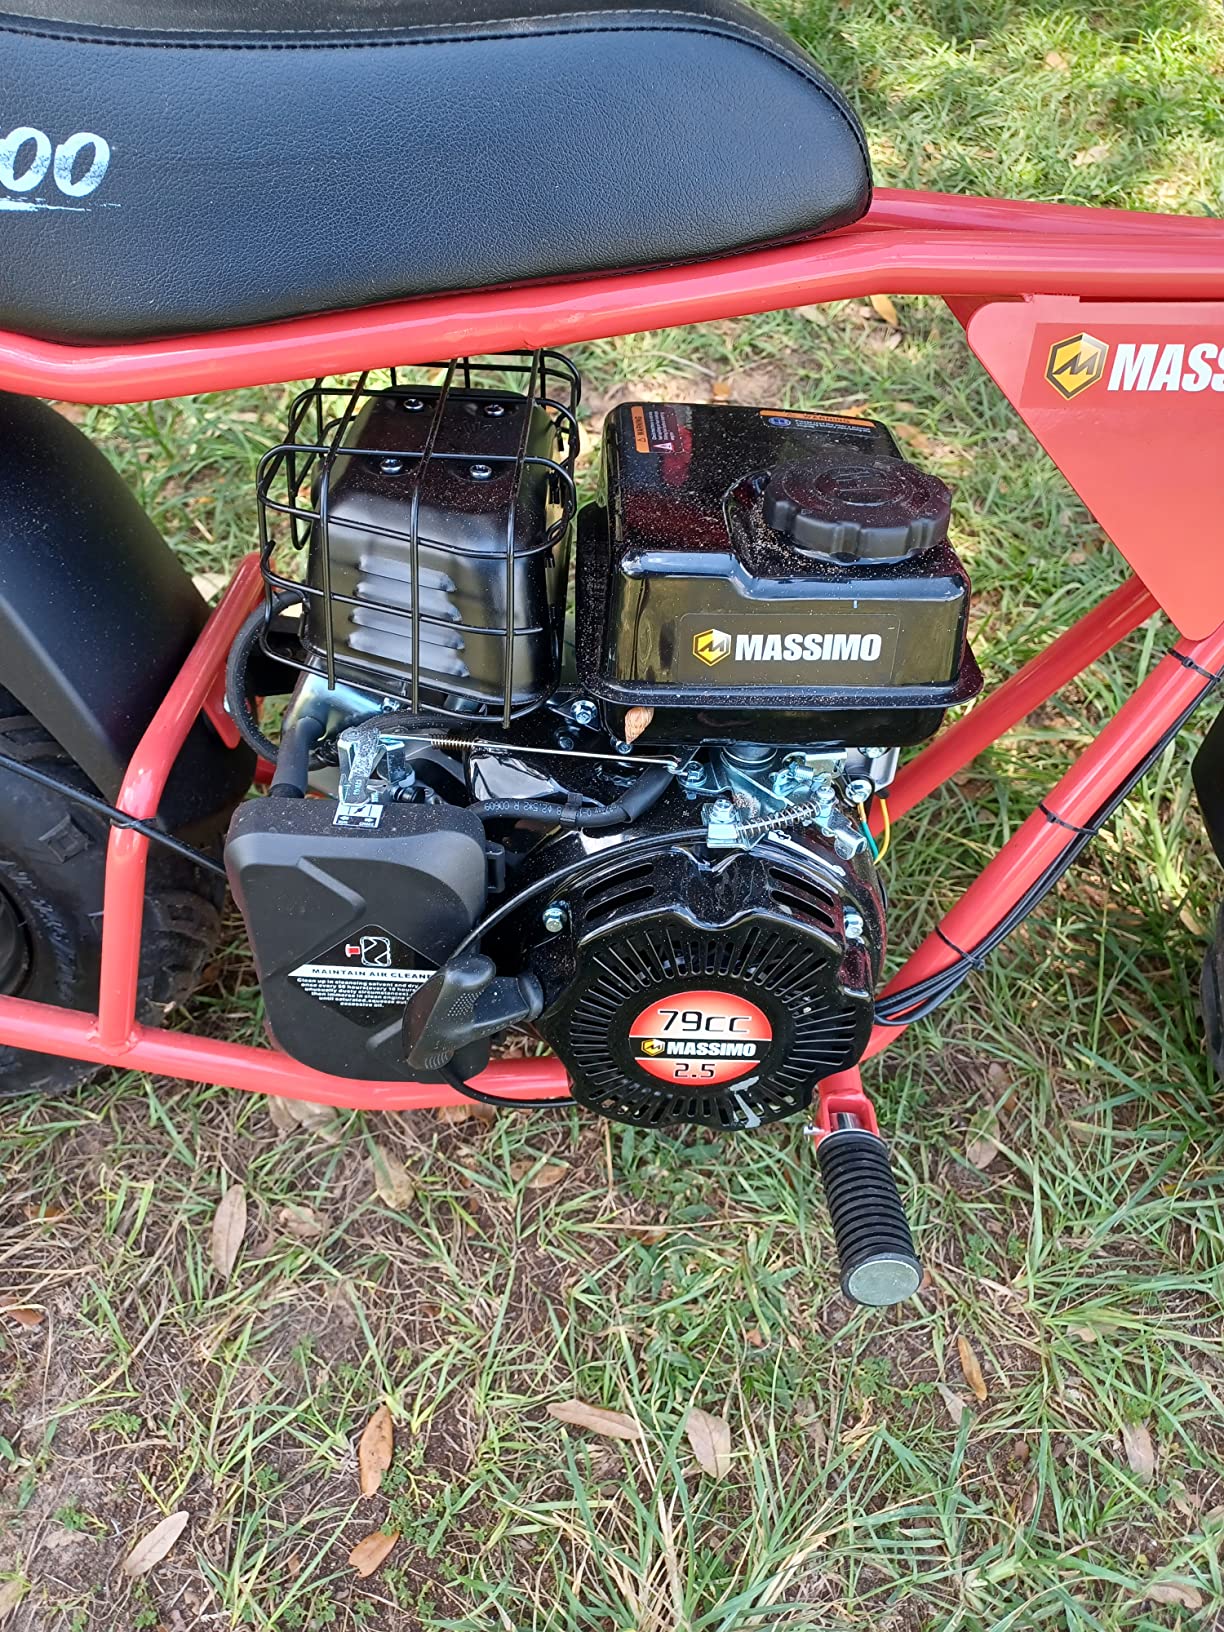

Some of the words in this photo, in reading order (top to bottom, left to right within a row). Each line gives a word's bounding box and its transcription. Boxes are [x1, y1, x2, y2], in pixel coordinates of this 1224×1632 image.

[735, 633, 882, 661] MASSIMO
[311, 968, 366, 976] MAINTAIN
[658, 1009, 752, 1033] 79cc
[666, 1041, 757, 1057] MASSIMO
[674, 1062, 716, 1078] 2.5
